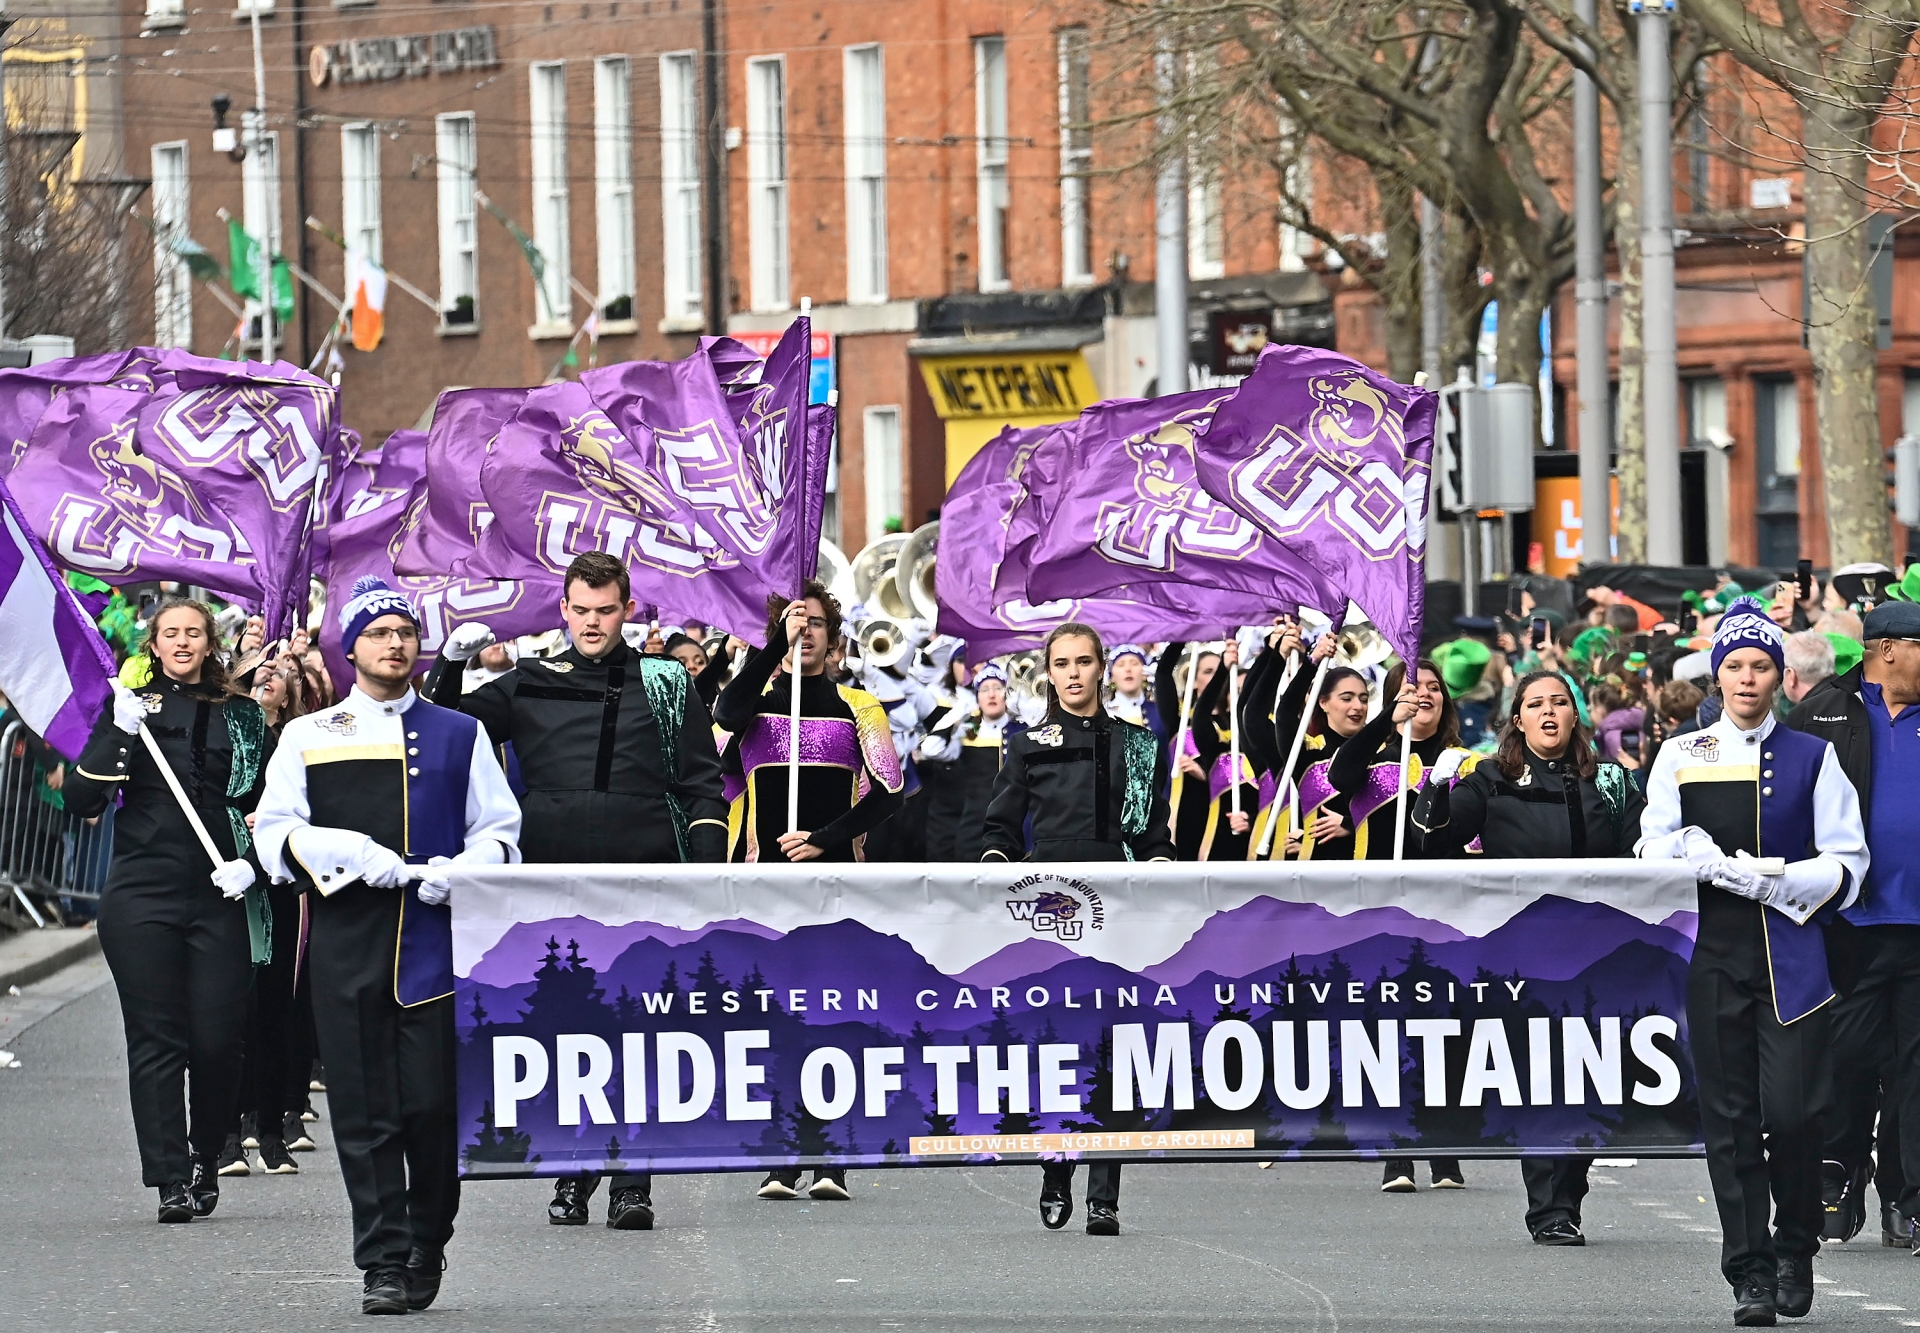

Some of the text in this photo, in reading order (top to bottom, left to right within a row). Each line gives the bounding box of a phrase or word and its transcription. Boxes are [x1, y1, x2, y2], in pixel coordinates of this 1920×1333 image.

[365, 598, 419, 621] WCU
[1721, 628, 1773, 647] WCU
[1678, 740, 1720, 762] WCU
[1007, 873, 1043, 894] PRIDE
[1056, 875, 1069, 884] THE
[1068, 879, 1105, 931] MOUNTAINS
[1006, 901, 1083, 941] WCU
[642, 980, 1526, 1014] WESTERN CAROLINA UNIVERSITY
[492, 1014, 1682, 1128] PRIDE OF THE MOUNTAINS
[917, 1132, 1248, 1152] CULLOWHEE, NORTH CAROLINA
